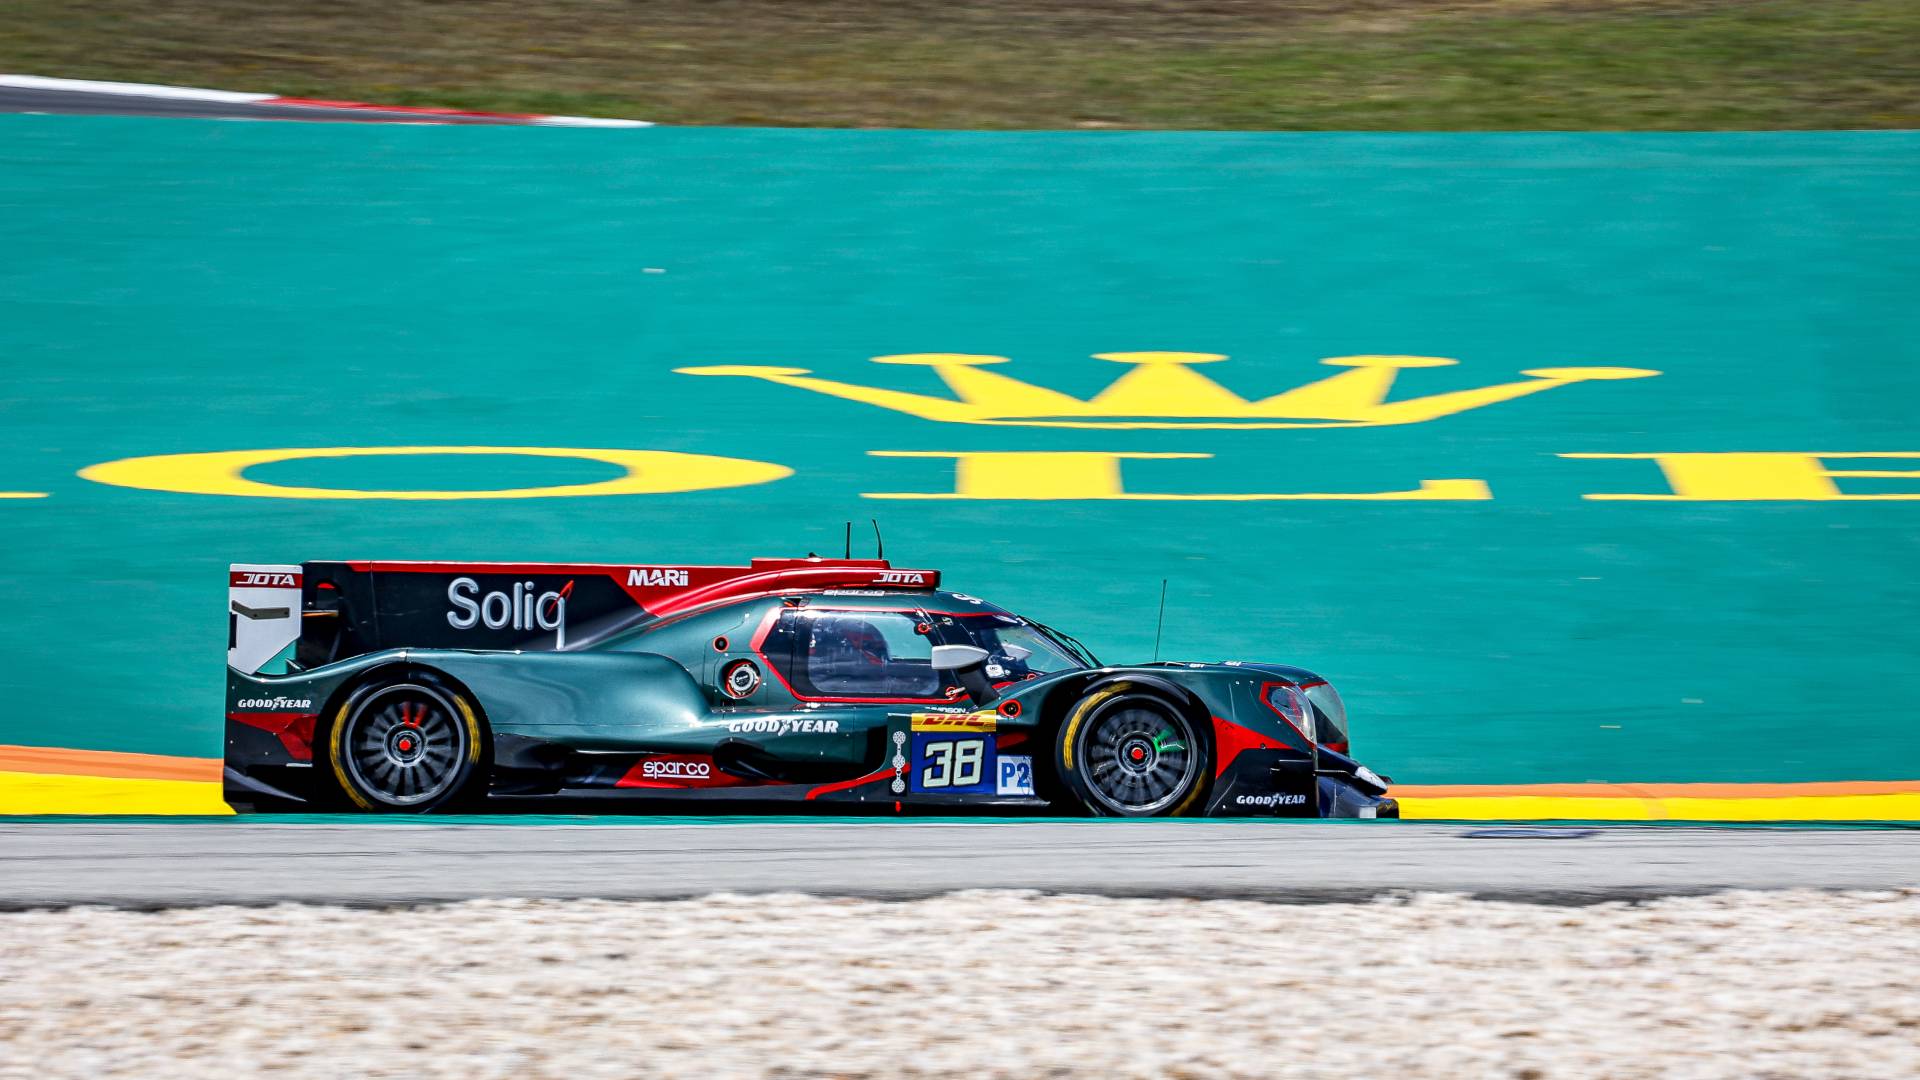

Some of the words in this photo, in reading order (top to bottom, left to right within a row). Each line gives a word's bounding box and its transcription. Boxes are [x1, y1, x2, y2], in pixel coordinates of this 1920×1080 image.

[236, 573, 296, 586] JOTA
[872, 572, 924, 584] JOTA
[447, 577, 573, 650] Soliq
[237, 696, 312, 711] GOODYEAR
[729, 719, 839, 736] GOODYEAR
[922, 714, 986, 727] DHL
[642, 761, 710, 779] sparco
[922, 739, 984, 788] 38
[1001, 762, 1030, 788] P2
[1236, 793, 1306, 808] GOODYEAR
